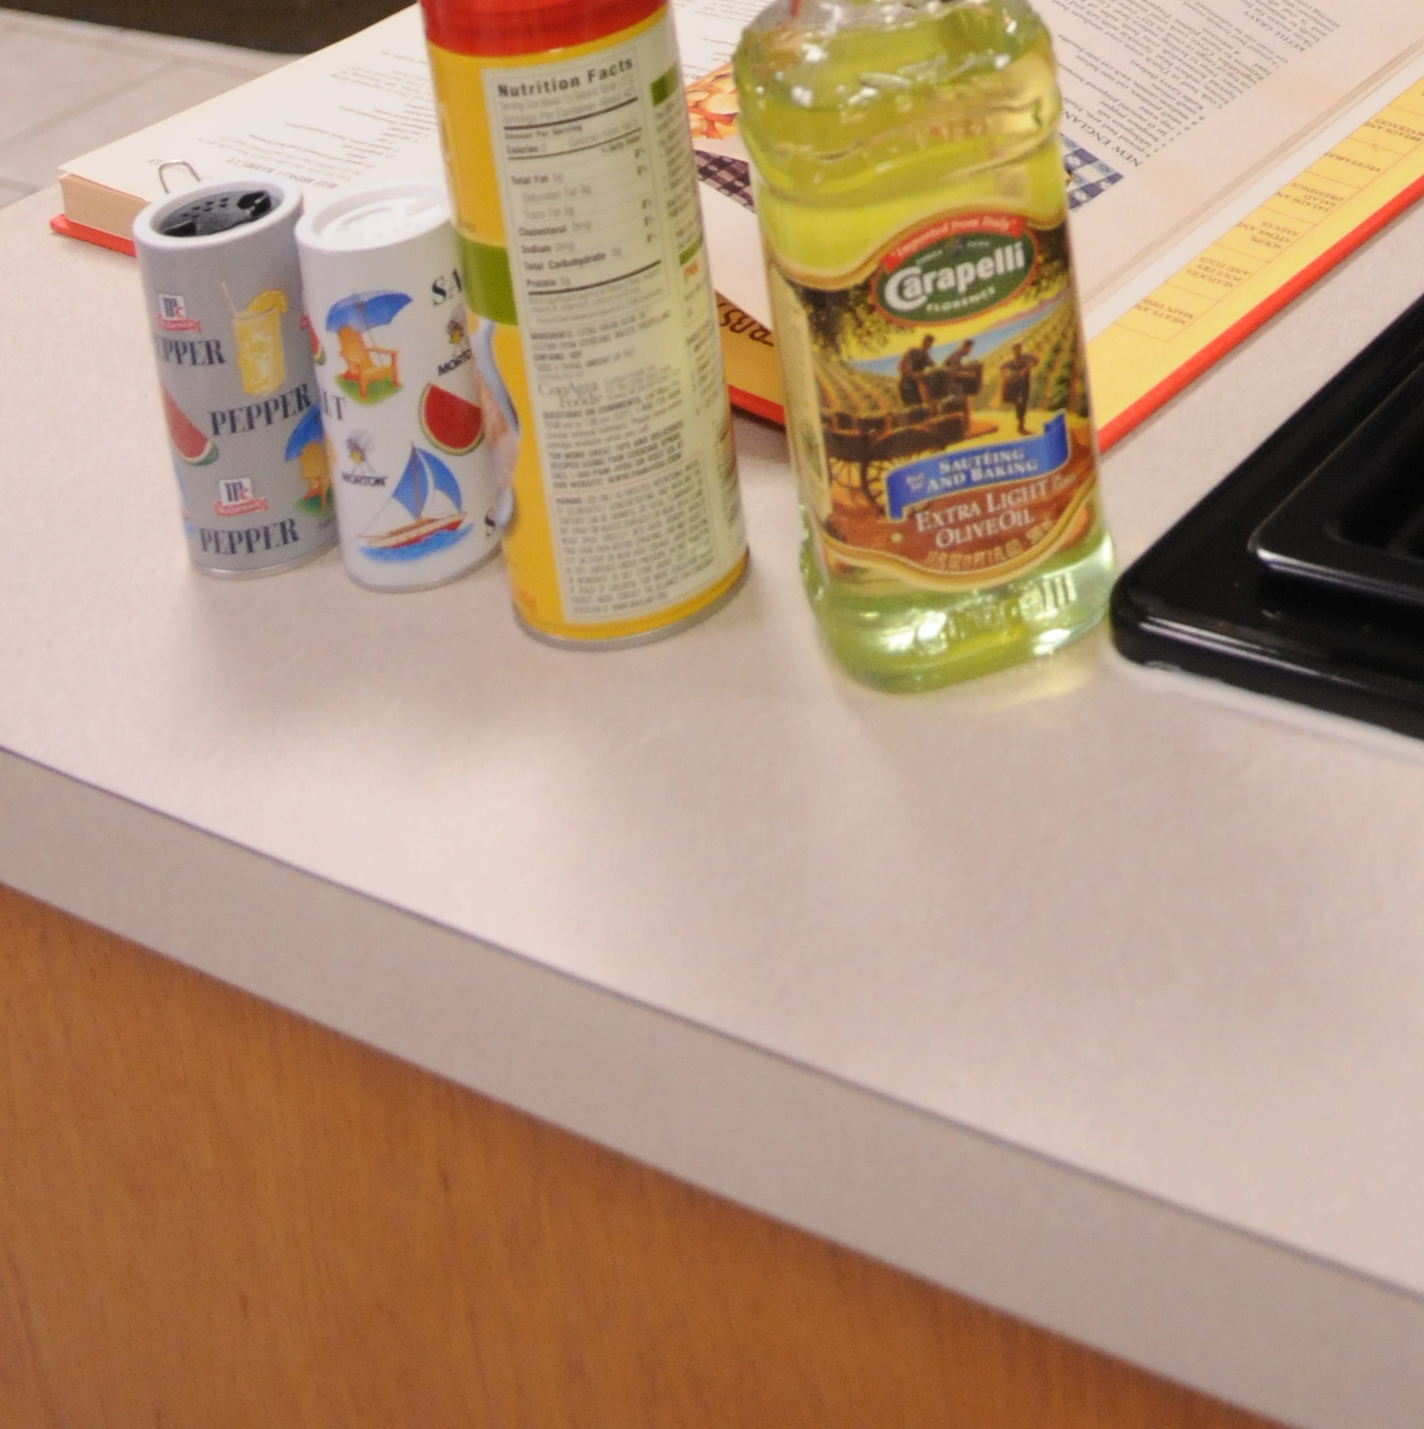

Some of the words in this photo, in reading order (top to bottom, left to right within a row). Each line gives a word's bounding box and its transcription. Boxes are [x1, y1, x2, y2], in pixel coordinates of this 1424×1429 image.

[498, 76, 580, 98] Nutrition
[587, 57, 634, 84] Facts
[1055, 108, 1114, 145] ENGLAN
[1108, 144, 1144, 167] NEW
[884, 241, 1027, 312] Carapelli
[208, 383, 312, 436] PEPPER
[926, 470, 967, 493] AND
[970, 460, 1039, 482] BAKING
[915, 500, 982, 533] EXTRA
[985, 481, 1049, 513] LIGHT
[200, 517, 300, 555] PEPPER
[935, 517, 1000, 549] OLIVE
[999, 508, 1035, 530] OIL
